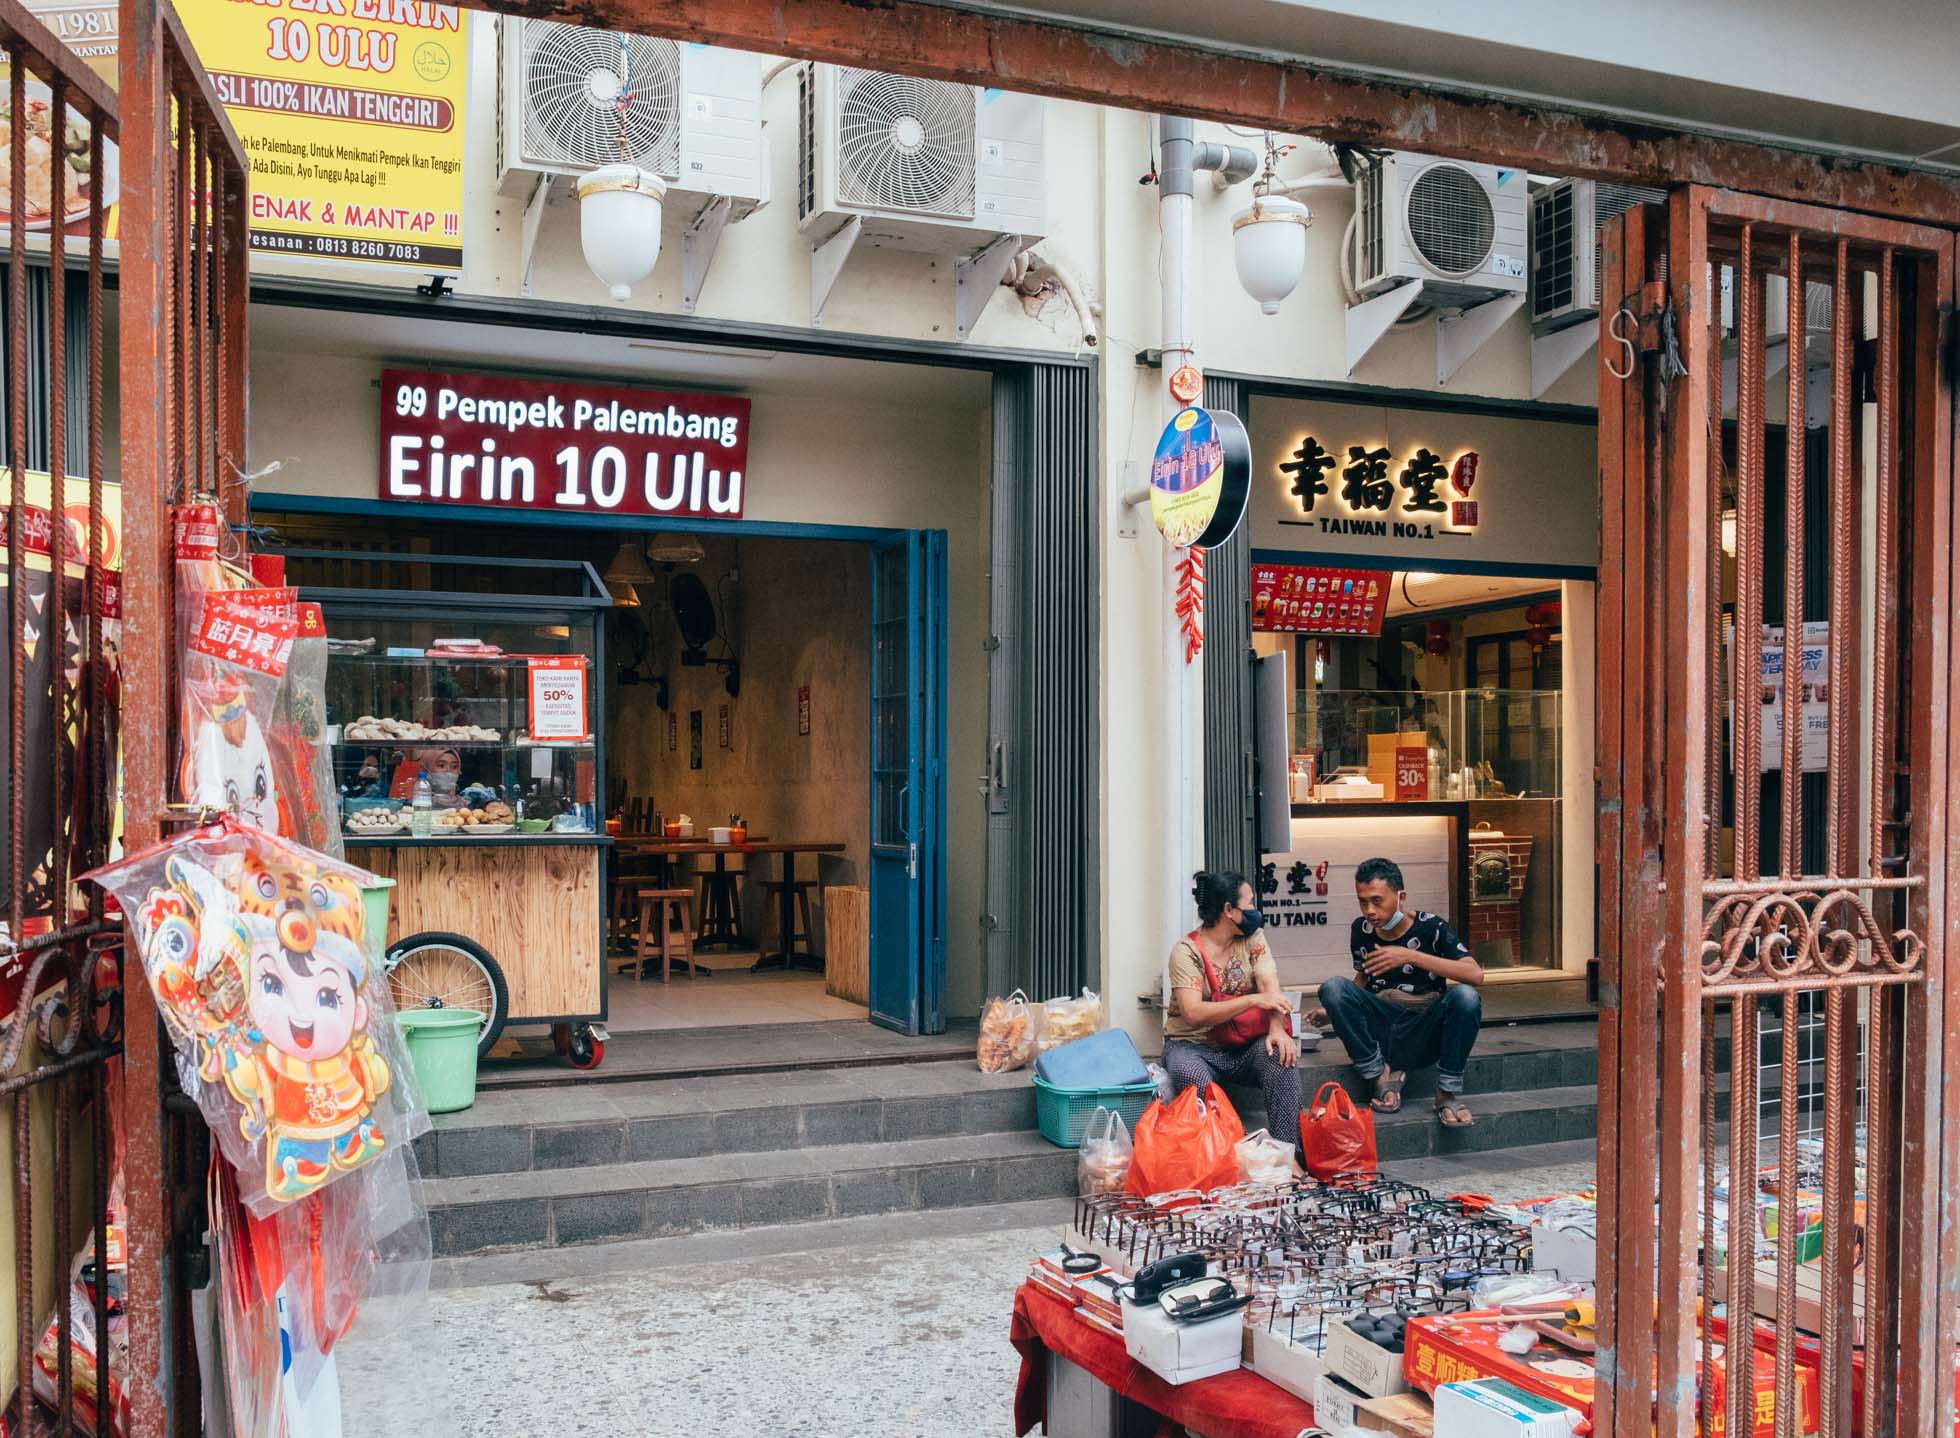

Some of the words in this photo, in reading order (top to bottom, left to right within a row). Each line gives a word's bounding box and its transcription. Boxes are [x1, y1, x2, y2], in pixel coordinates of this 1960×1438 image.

[56, 11, 114, 36] 1981
[267, 17, 310, 62] 10
[316, 24, 398, 72] ULU
[251, 79, 299, 111] 100%
[304, 86, 349, 117] IKAN
[353, 91, 438, 127] TENGGIRI
[250, 137, 261, 150] ke
[262, 137, 309, 159] Palembang,
[310, 142, 334, 159] Untuk
[336, 146, 378, 164] Menikmati
[379, 150, 411, 169] Pempek
[412, 154, 429, 169] Ikan
[430, 156, 461, 174] Tenggiri
[253, 158, 268, 173] Ada
[270, 160, 296, 176] Disini,
[297, 163, 312, 180] Ayo
[313, 165, 342, 183] Tunggu
[344, 168, 359, 185] Apa
[360, 170, 377, 187] Lagi
[252, 194, 312, 222] ENAK
[321, 202, 335, 224] &
[345, 205, 435, 232] MANTAP
[444, 213, 458, 236] !!!
[316, 238, 348, 254] 0813
[351, 242, 384, 256] 8260
[388, 244, 420, 260] 7083
[396, 385, 426, 416] 99
[438, 388, 564, 432] Pempek
[574, 400, 738, 448] Palembang
[389, 434, 535, 503] Eirin
[555, 446, 627, 508] 10
[644, 451, 741, 514] Ulu
[1279, 437, 1449, 512] 幸福堂
[1319, 518, 1387, 537] TAIWAN
[1393, 522, 1434, 539] NO.1
[206, 617, 278, 657] 蓝月亮
[543, 690, 574, 701] 50%
[1398, 769, 1426, 787] 30%
[1284, 911, 1328, 927] TANG
